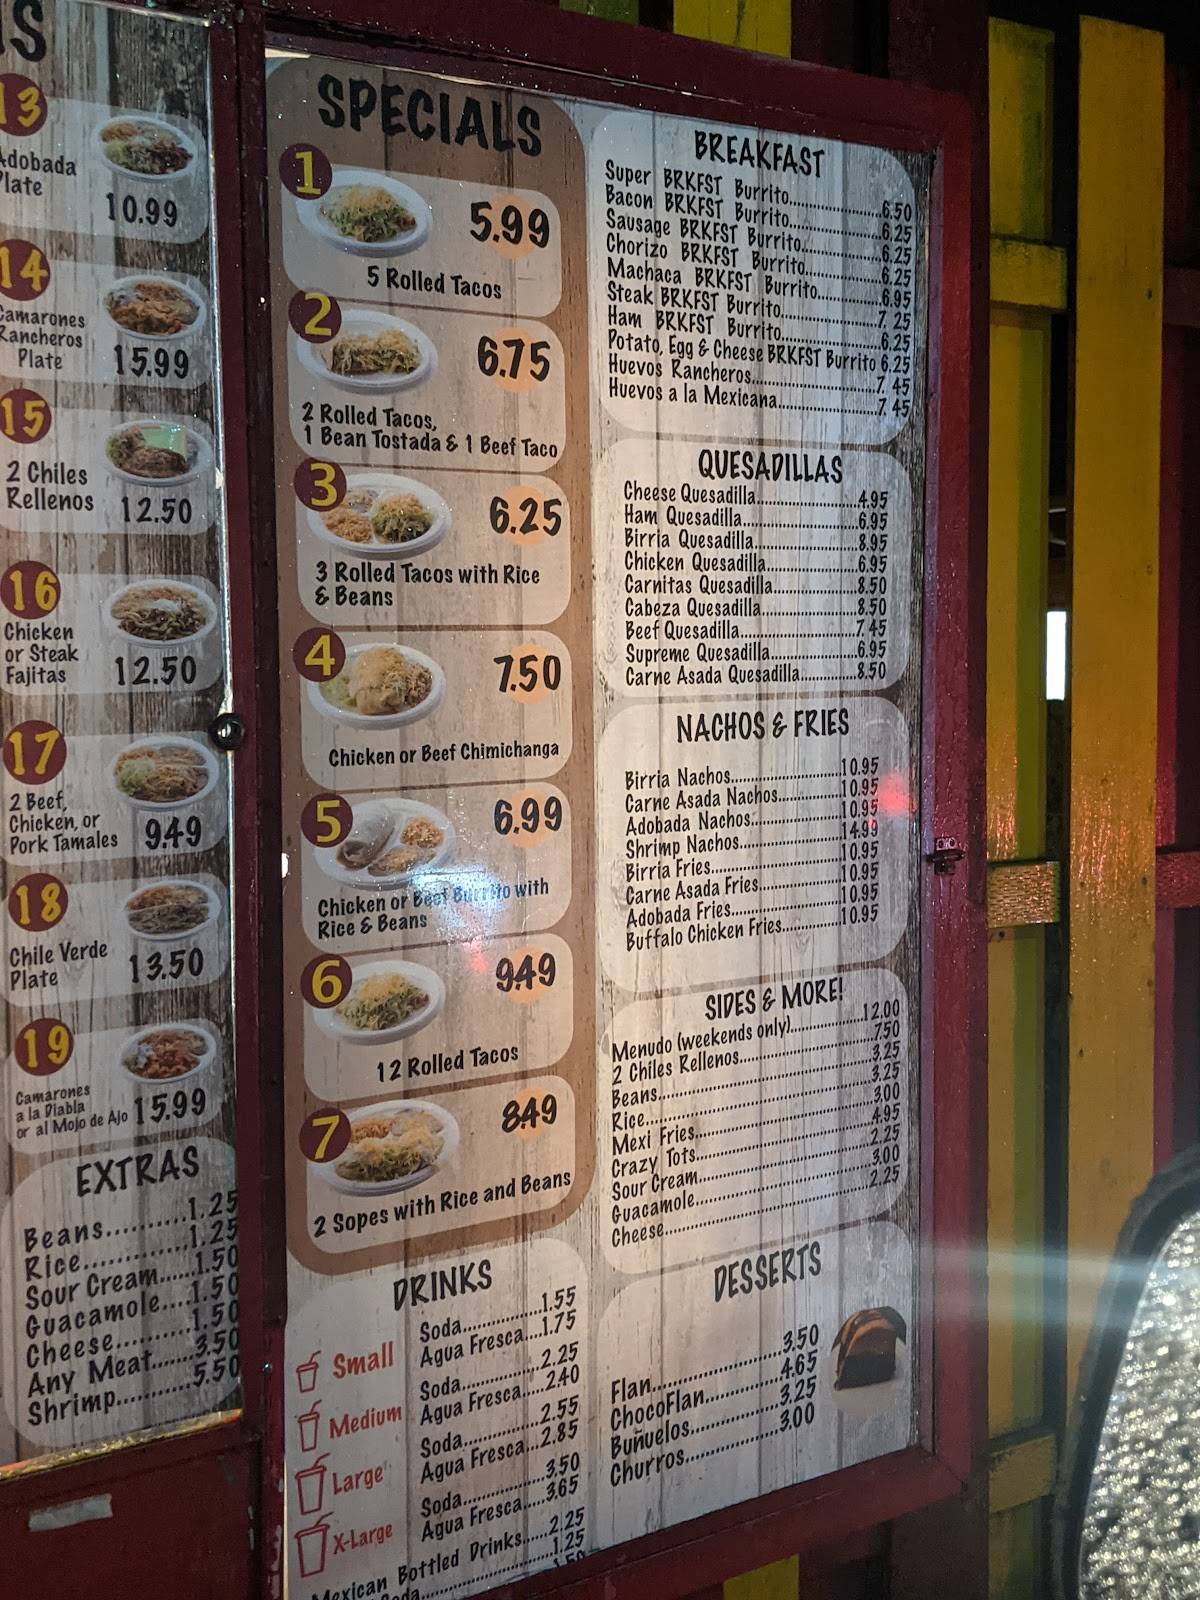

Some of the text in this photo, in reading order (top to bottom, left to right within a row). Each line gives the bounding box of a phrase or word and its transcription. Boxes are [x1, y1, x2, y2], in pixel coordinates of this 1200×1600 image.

[317, 74, 542, 157] SPECIALS
[694, 130, 825, 178] BREAKFAST
[295, 151, 321, 195] 1
[605, 160, 722, 196] Super BRKFST
[105, 193, 178, 227] 10.99
[605, 184, 723, 219] Bacon BRKFST
[470, 201, 550, 248] 5.99
[606, 208, 738, 245] Sausage BRKFST
[606, 233, 739, 268] Chorizo BRKFST
[0, 247, 48, 292] 14
[368, 265, 502, 299] 5 Rolled Tacos
[607, 257, 752, 293] Machaca BRKFST
[608, 281, 719, 312] Steak BRKFST
[304, 293, 332, 336] 2
[18, 347, 62, 371] Plate
[115, 344, 189, 380] 15.99
[477, 336, 550, 382] 6.75
[608, 329, 911, 374] Potato, Egg & Cheese BRKFST Burrito 6.25
[609, 354, 662, 377] Huevos
[1, 398, 46, 438] 15
[302, 402, 437, 431] 2 Rolled Tacos,
[304, 425, 558, 458] 1 Bean Tostada & 1 Beef Taco
[6, 462, 88, 485] 2 Chiles
[699, 449, 843, 483] QUESADILLAS
[6, 488, 94, 510] Rellenos
[310, 463, 337, 507] 3
[625, 480, 676, 502] Cheese
[121, 497, 193, 524] 12.50
[490, 496, 561, 536] 6.25
[625, 504, 657, 524] Ham
[625, 528, 670, 548] Birria
[316, 561, 540, 584] 3 Rolled Tacos with Rice
[625, 551, 684, 571] Chicken
[10, 570, 56, 611] 16
[315, 586, 393, 606] & Beans
[625, 574, 692, 594] Carnitas
[625, 597, 680, 617] Cabeza
[5, 622, 73, 641] Chicken
[6, 644, 79, 663] or Steak
[115, 656, 197, 685] 12.50
[305, 635, 335, 676] 4
[625, 643, 690, 666] Supreme
[6, 667, 67, 687] Fajitas
[494, 654, 561, 693] 7.50
[677, 708, 849, 743] NACHOS & FRIES
[8, 730, 60, 776] 17
[329, 741, 559, 768] Chicken or Beef Chimichanga
[625, 771, 670, 790] Birria
[10, 791, 67, 814] 2 Beef,
[494, 796, 562, 836] 6.99
[625, 790, 720, 813] Carne Asada
[10, 813, 100, 833] Chicken, or
[145, 816, 201, 850] 9.49
[316, 800, 341, 842] 5
[626, 815, 690, 836] Adobada
[10, 832, 118, 854] Pork Tamales
[626, 839, 680, 859] Shrimp
[16, 883, 60, 925] 18
[318, 894, 386, 918] Chicken
[391, 895, 408, 909] or
[515, 878, 549, 899] with
[318, 912, 427, 940] Rice & Beans
[626, 918, 744, 952] Buffalo Chicken
[10, 940, 108, 967] Chile Verde
[129, 948, 204, 983] 13.50
[11, 967, 58, 990] Plate
[312, 960, 343, 1003] 6
[496, 952, 556, 992] 9.49
[705, 976, 844, 1021] SIDES & MORE!
[24, 1025, 69, 1068] 19
[612, 1025, 752, 1063] Menudo (weekends
[408, 1050, 464, 1078] Rolled
[470, 1046, 518, 1068] Tacos
[613, 1061, 672, 1085] 2 Chiles
[16, 1085, 90, 1106] Camarones
[16, 1102, 85, 1122] a la Diabla
[134, 1088, 206, 1125] 15.99
[17, 1111, 128, 1139] or al Mojo de Ajo
[501, 1094, 558, 1133] 8.49
[311, 1115, 340, 1160] 7
[77, 1145, 199, 1197] EXTRAS
[612, 1155, 658, 1179] Crazy
[314, 1171, 571, 1238] 2 Sopes with Rice and Beans
[394, 1259, 493, 1311] DRINKS
[715, 1241, 822, 1303] DESSERTS
[333, 1341, 394, 1379] Small
[329, 1405, 402, 1439] Medium
[333, 1464, 384, 1495] Large
[333, 1523, 393, 1556] X-Large
